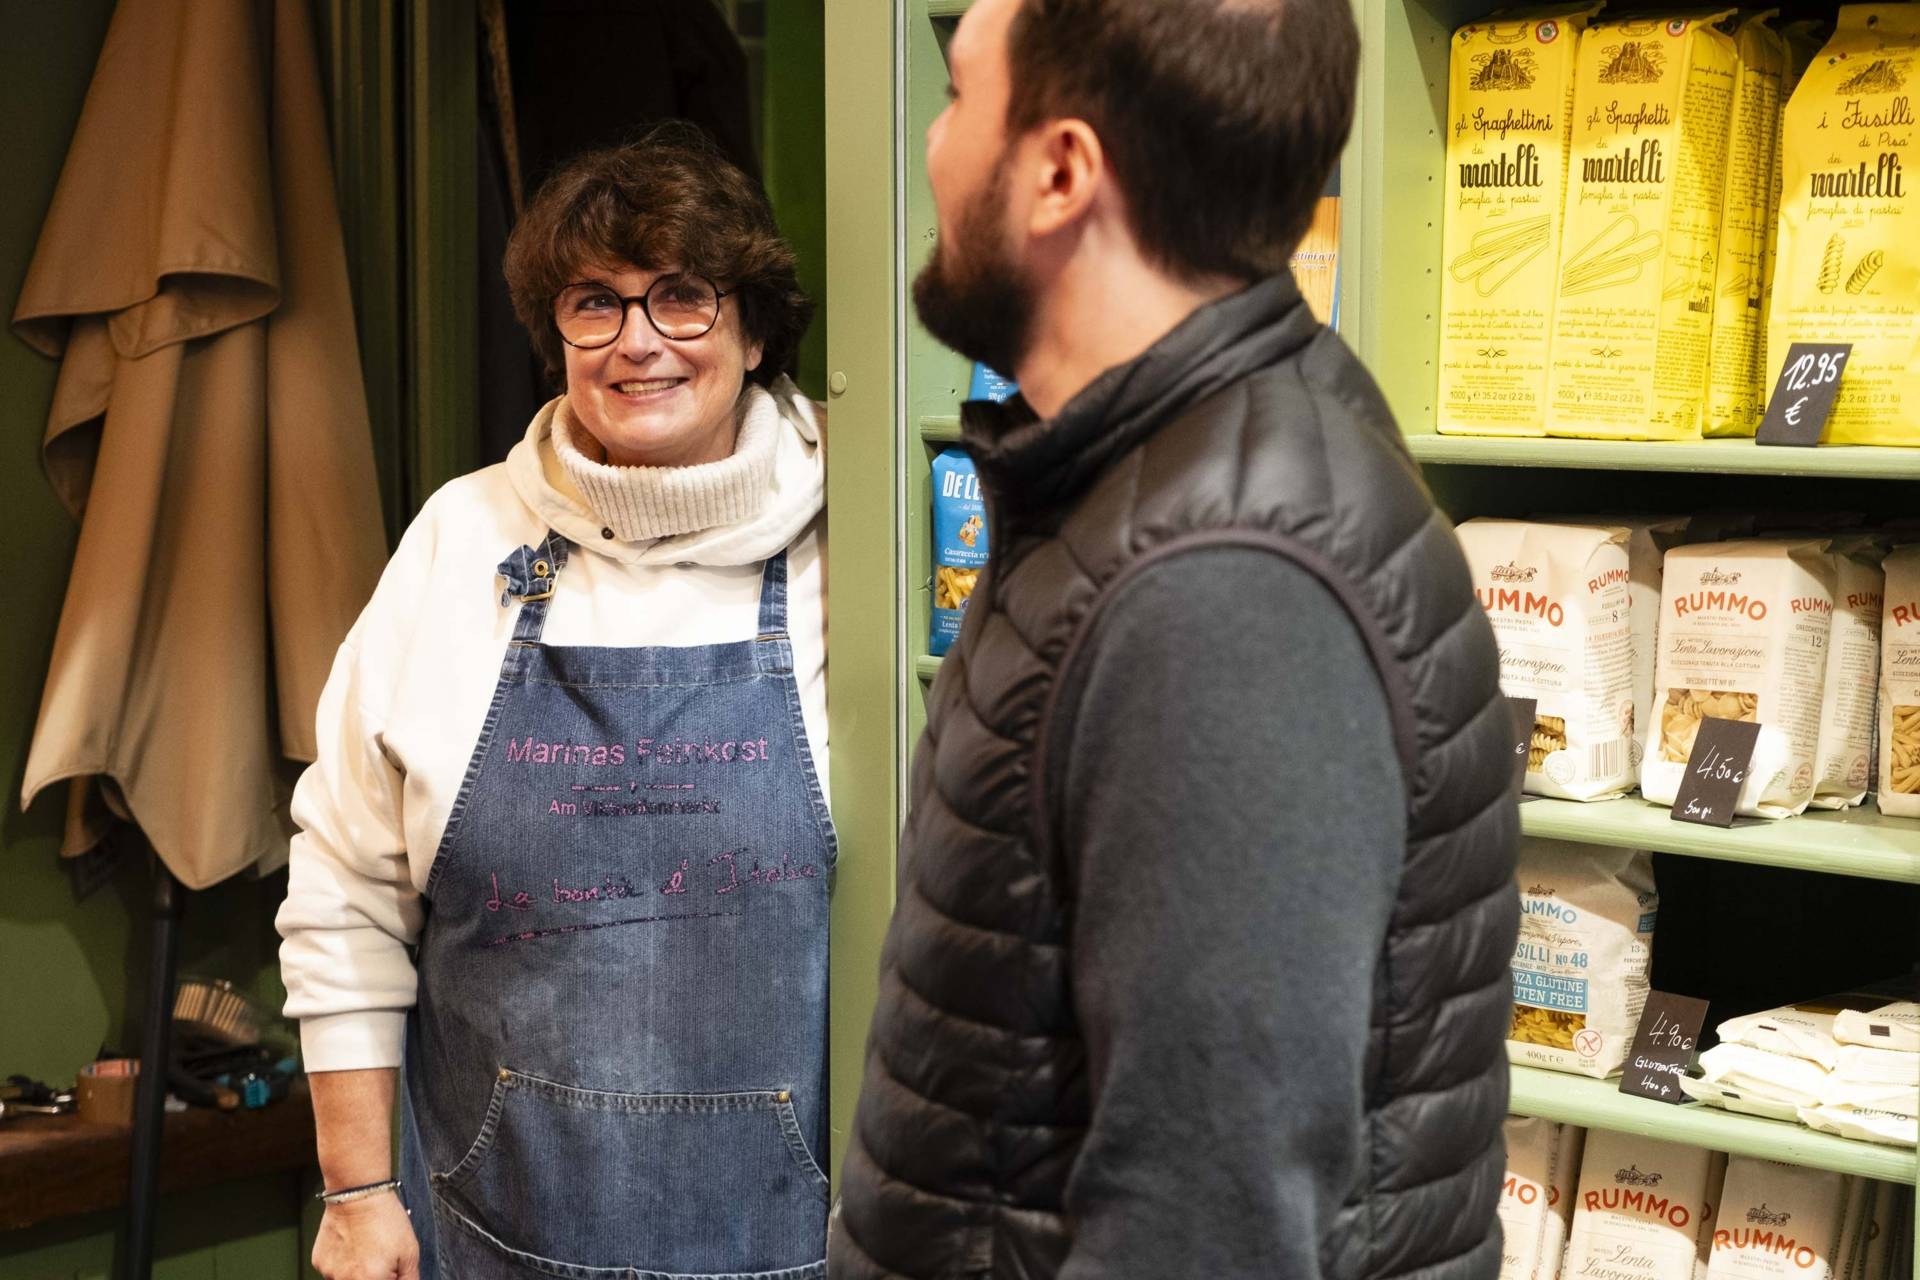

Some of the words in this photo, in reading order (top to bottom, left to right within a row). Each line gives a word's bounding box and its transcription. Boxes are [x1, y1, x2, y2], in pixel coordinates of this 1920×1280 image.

[1455, 113, 1468, 138] gli
[1471, 106, 1554, 141] Spaghettini
[1587, 106, 1601, 131] gli
[1605, 100, 1671, 135] Spaghetti
[1841, 96, 1915, 129] Fusilli
[1858, 134, 1870, 147] di
[1878, 131, 1909, 147] Pisa
[1459, 143, 1543, 189] martelli
[1582, 138, 1665, 184] martelli
[1810, 152, 1906, 198] martelli
[1784, 353, 1846, 391] 12.95
[1784, 397, 1809, 425] €
[1476, 587, 1564, 627] UMMO
[1674, 591, 1767, 621] RUMMO
[1790, 597, 1834, 617] RUMM
[1847, 592, 1884, 609] RUM
[1698, 640, 1766, 661] Lavorazione
[1811, 635, 1822, 648] 12
[507, 736, 626, 766] Marinas
[637, 735, 769, 765] Feinkost
[548, 800, 577, 816] Am
[1519, 899, 1578, 924] UMMO
[1516, 943, 1550, 964] SILLI
[1570, 952, 1589, 969] 48
[1512, 971, 1533, 986] NZA
[1535, 975, 1584, 993] GLUTINE
[1513, 985, 1545, 1004] UTEN
[1549, 990, 1584, 1009] FREE
[1584, 1188, 1690, 1228] RUMMO
[1606, 1244, 1656, 1269] Lenta
[1713, 1228, 1817, 1269] RUMMO
